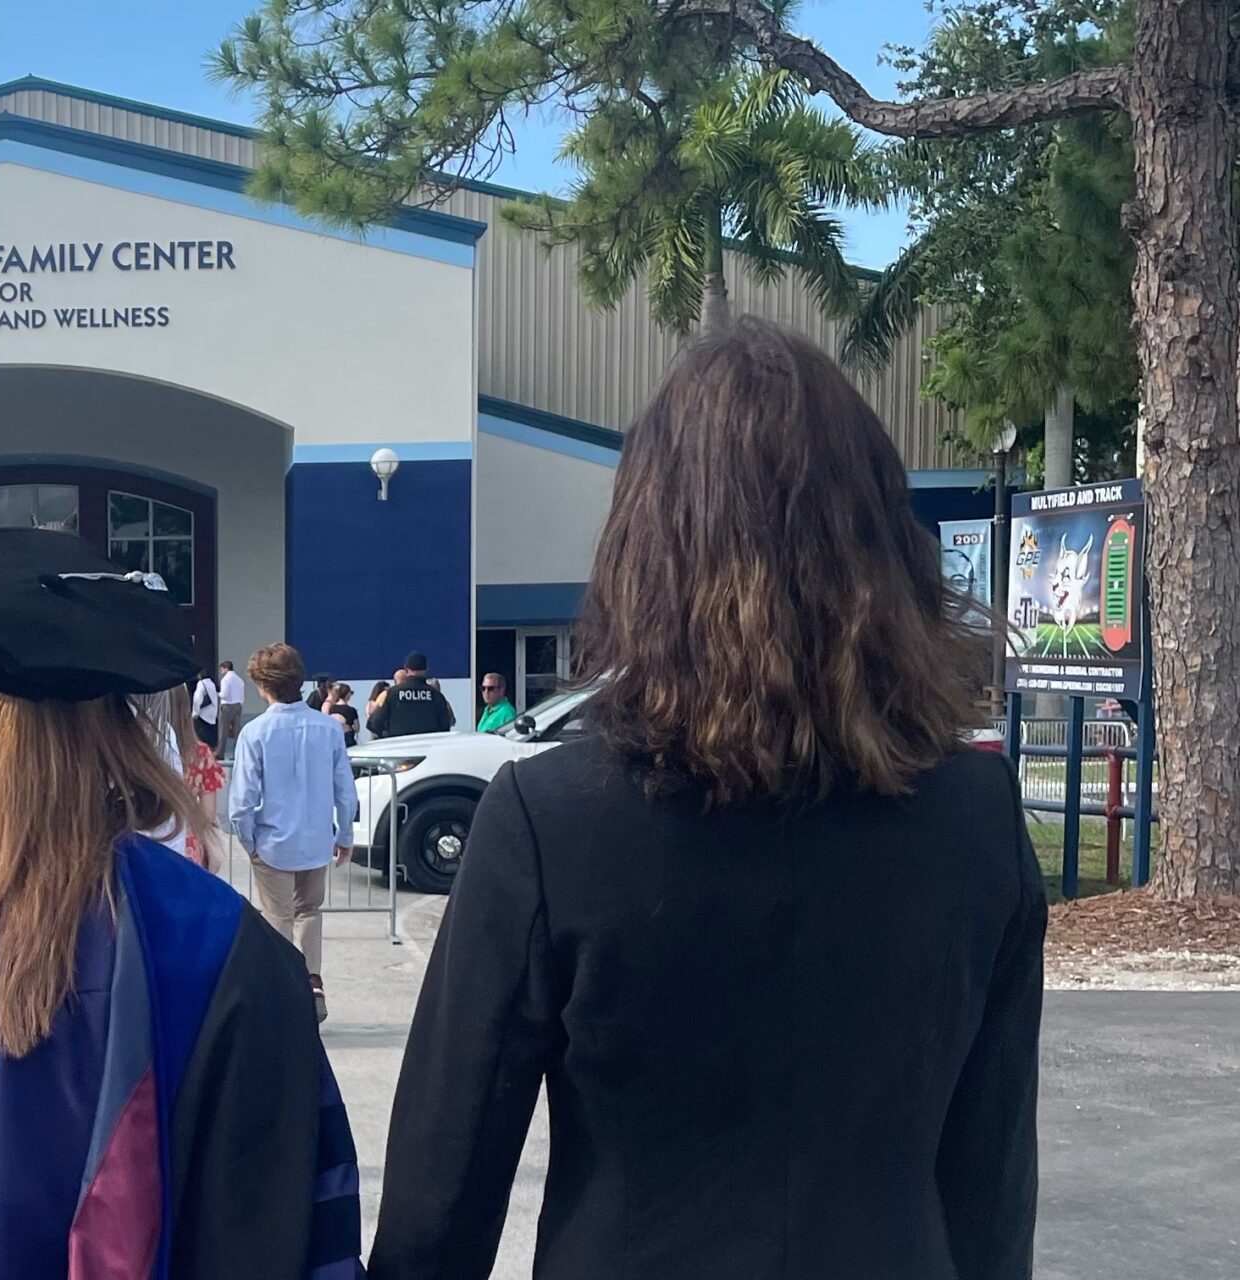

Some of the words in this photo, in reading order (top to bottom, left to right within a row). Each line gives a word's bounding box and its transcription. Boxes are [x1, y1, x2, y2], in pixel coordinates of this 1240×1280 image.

[111, 239, 236, 271] CENTER
[53, 307, 170, 329] WELLNESS
[1031, 491, 1076, 511] MULTIFIELD
[1077, 489, 1094, 505] AND
[1094, 485, 1123, 503] TRACK
[1016, 551, 1040, 566] GPE
[398, 690, 432, 701] POLICE
